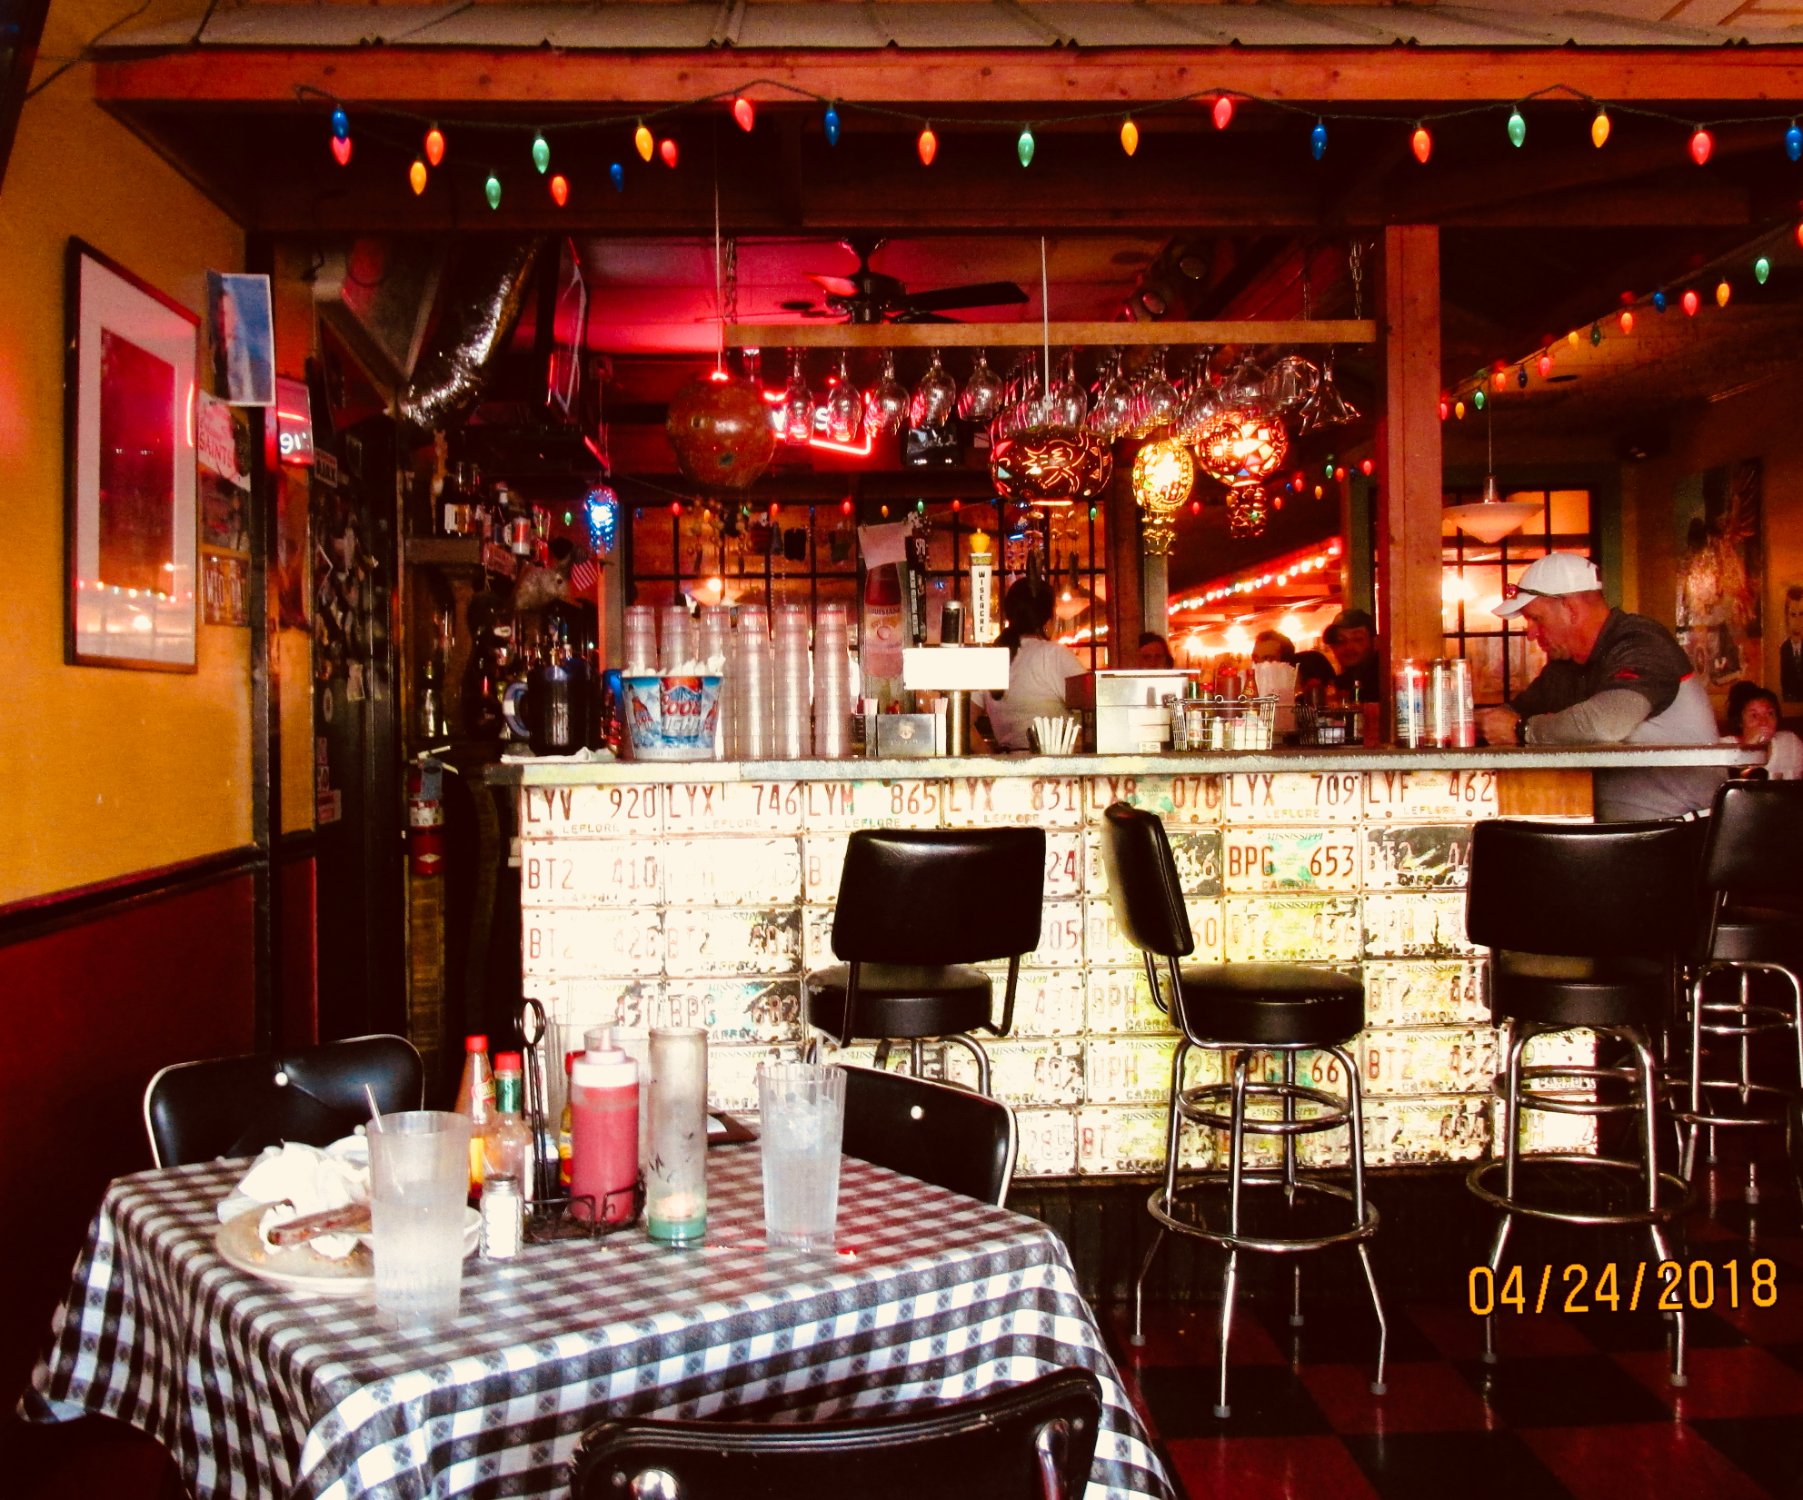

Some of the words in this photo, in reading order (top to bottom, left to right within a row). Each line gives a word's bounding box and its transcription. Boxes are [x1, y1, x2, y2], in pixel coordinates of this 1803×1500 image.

[978, 570, 986, 634] WISEACRE
[666, 784, 714, 818] LYX
[751, 784, 798, 816] 746
[808, 783, 854, 816] LYM
[890, 783, 937, 815] 865
[949, 778, 996, 812] LYX
[1030, 779, 1076, 811] 831
[1230, 774, 1275, 807] LYX
[1311, 774, 1355, 806] 709
[1367, 771, 1412, 803] LYF
[1449, 771, 1493, 803] 462
[526, 786, 573, 823] LYV
[609, 787, 656, 819] 920
[984, 813, 1039, 824] LEFLORE
[1267, 808, 1320, 818] LEFLORE
[844, 817, 901, 828] LEFLORE
[1267, 832, 1323, 841] MISSISSIPPI
[528, 858, 574, 890] BT2
[612, 856, 657, 889] 410
[1047, 850, 1076, 882] 24
[1310, 845, 1354, 877] 653
[1038, 918, 1079, 950] 05
[1193, 917, 1217, 948] 60
[1125, 1019, 1169, 1030] CARRO
[1188, 1052, 1219, 1084] 25
[1311, 1055, 1340, 1083] 66
